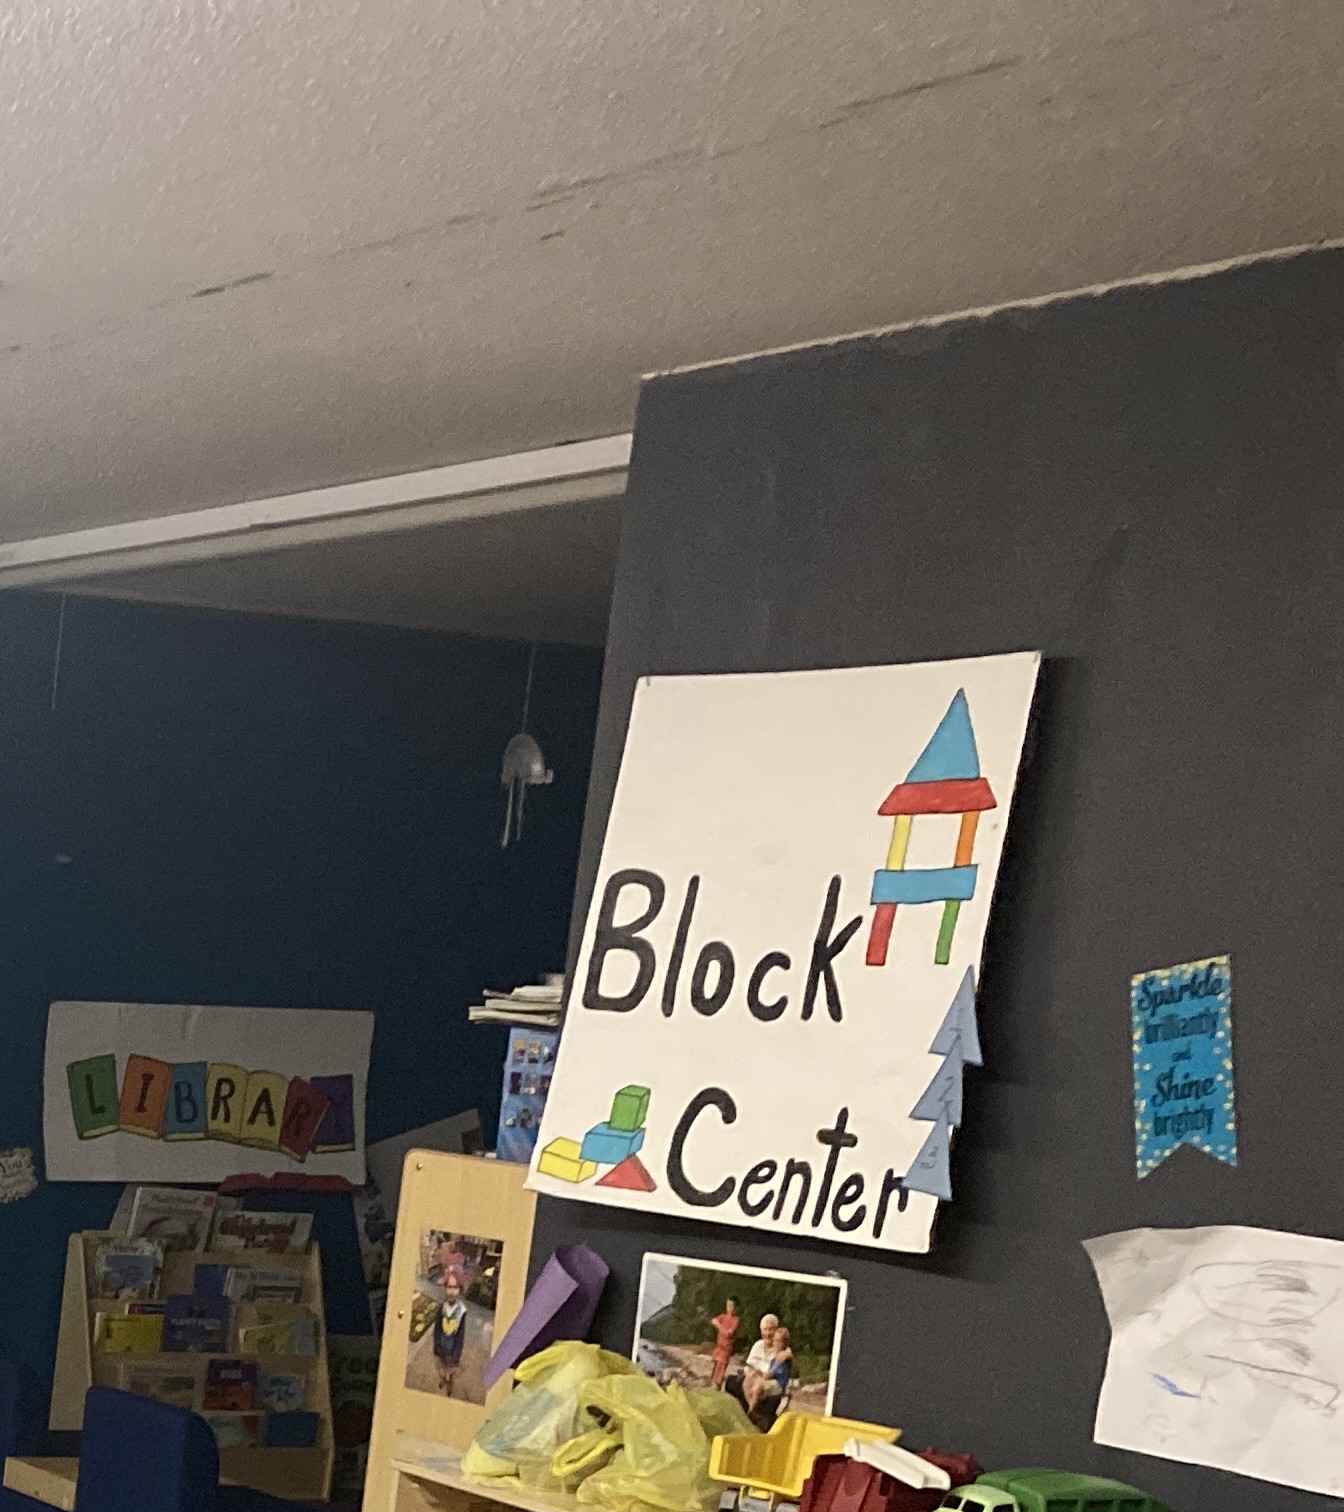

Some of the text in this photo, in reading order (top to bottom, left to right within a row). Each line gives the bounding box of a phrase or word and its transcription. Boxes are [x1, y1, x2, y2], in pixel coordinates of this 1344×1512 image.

[582, 867, 864, 1023] Block
[1137, 961, 1225, 1018] Sparkle
[1150, 1063, 1218, 1109] Shine
[666, 1086, 911, 1240] Center
